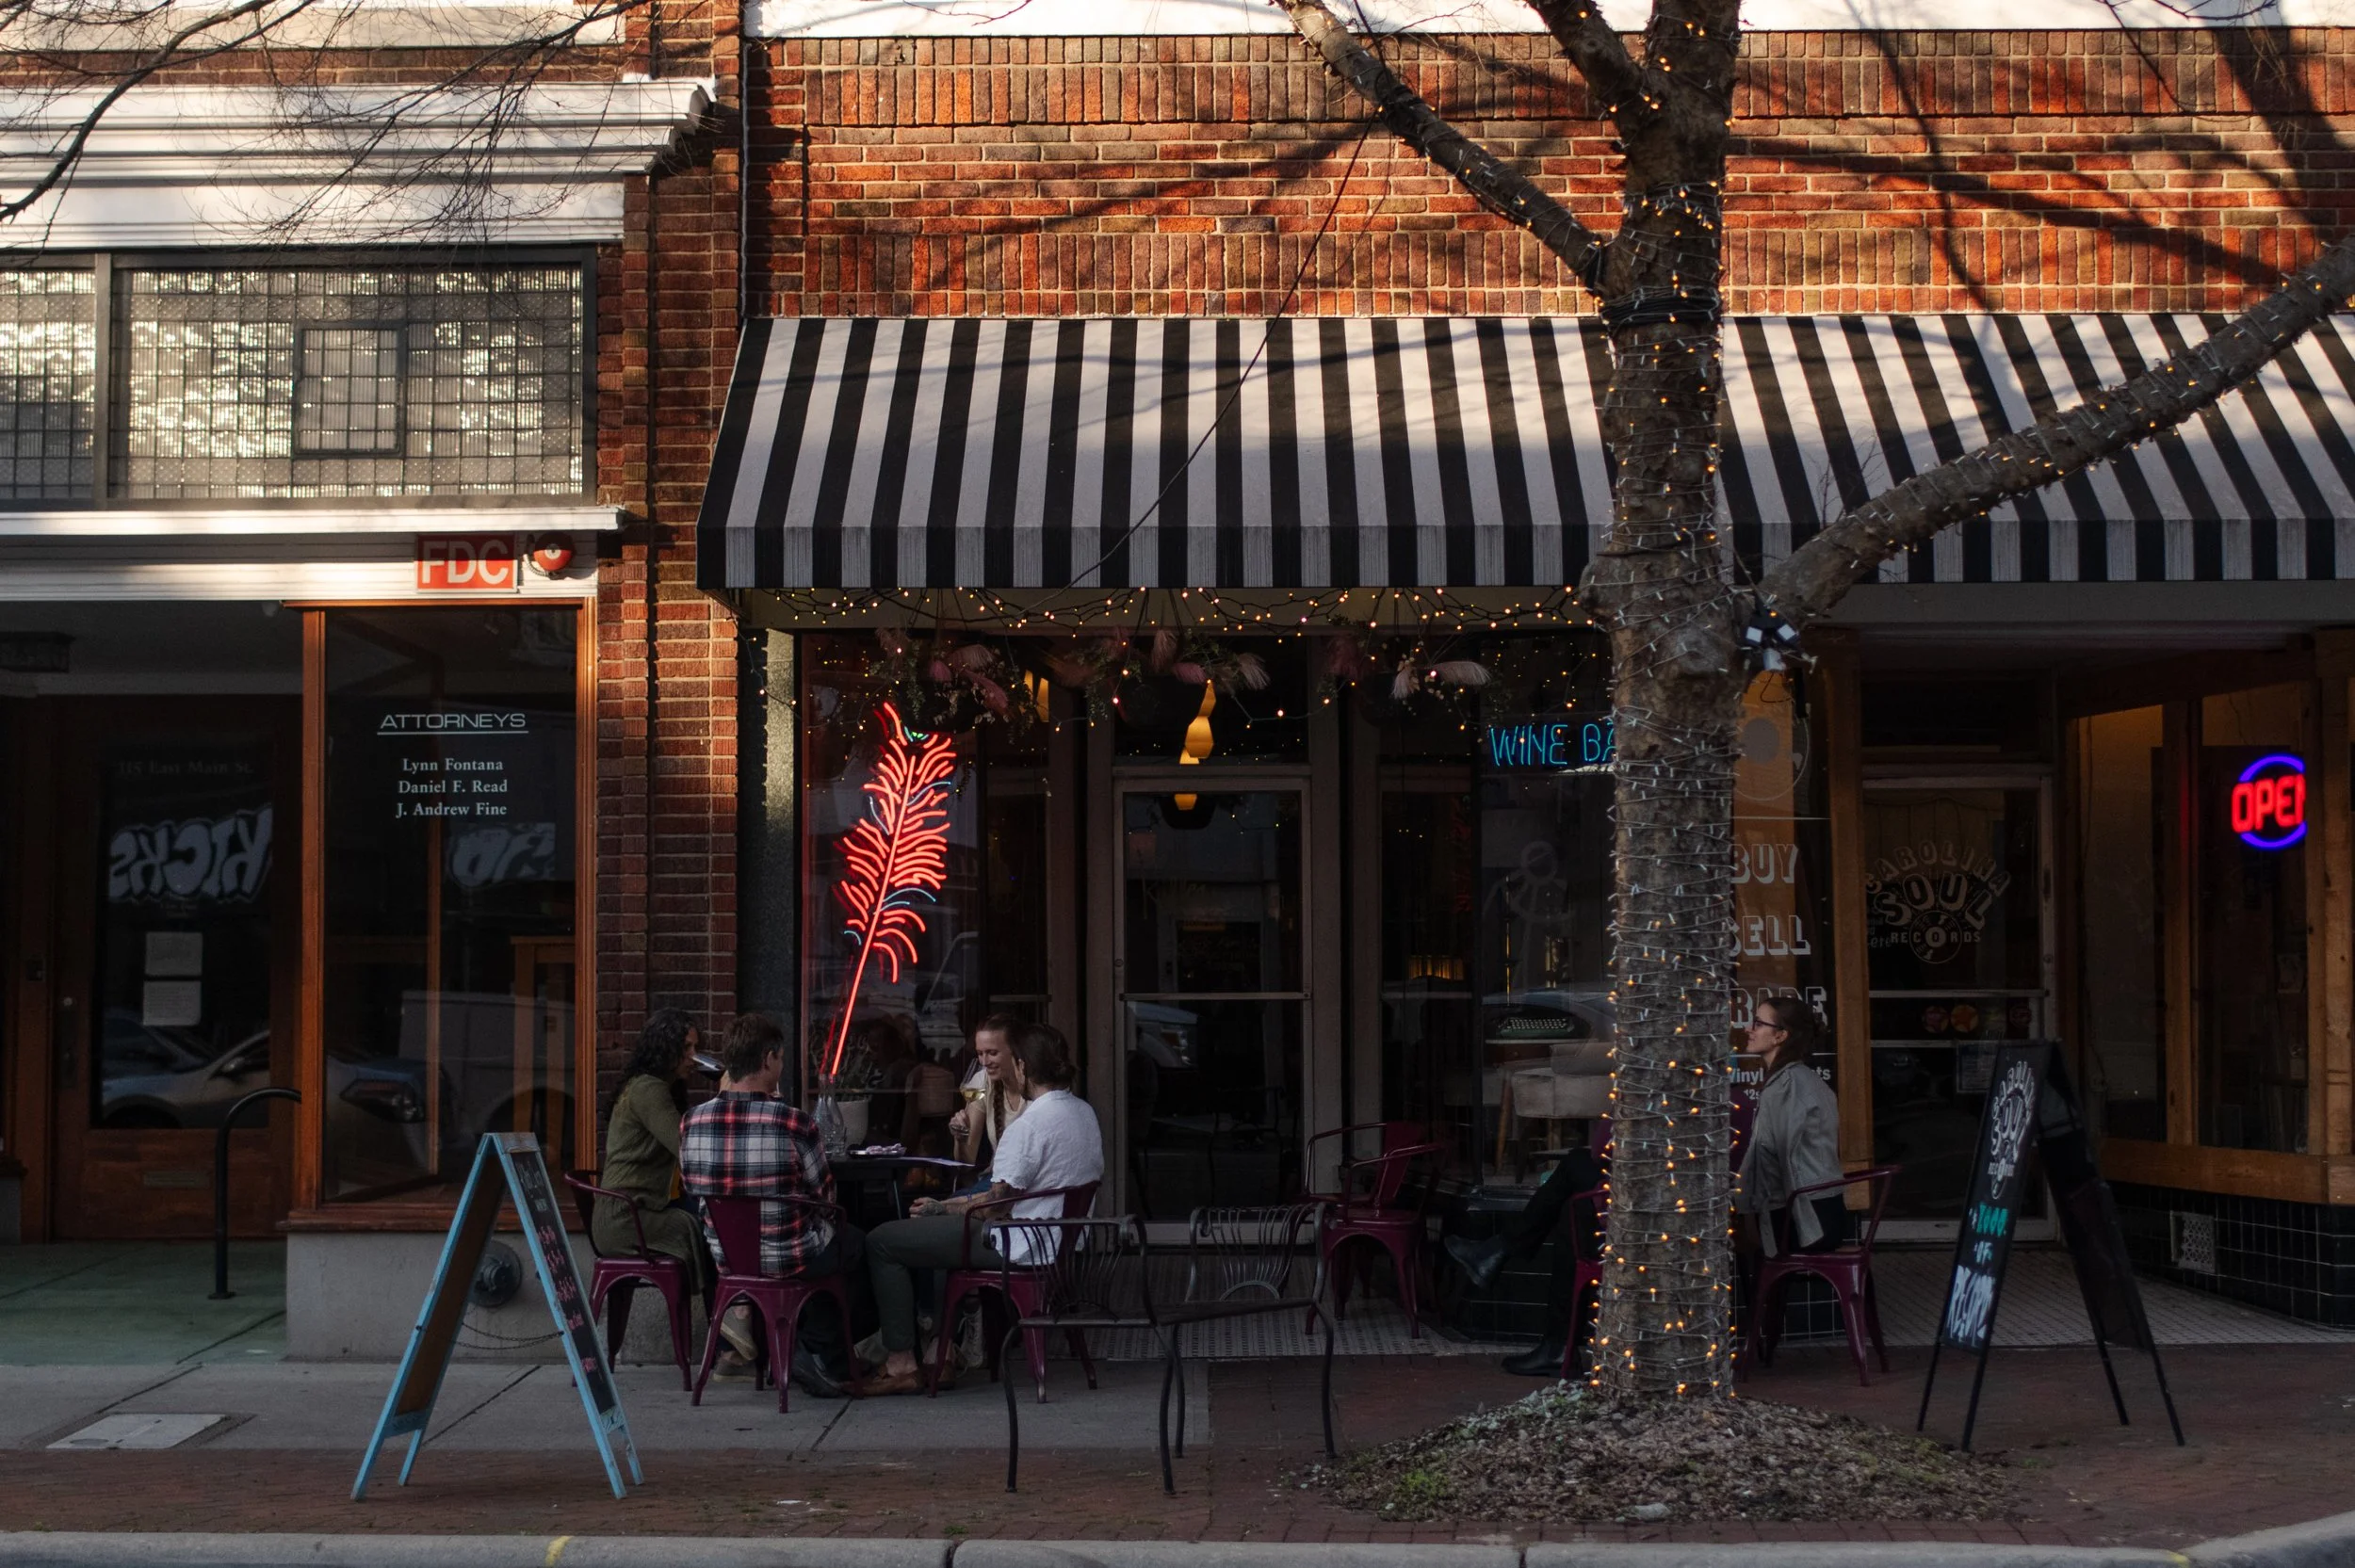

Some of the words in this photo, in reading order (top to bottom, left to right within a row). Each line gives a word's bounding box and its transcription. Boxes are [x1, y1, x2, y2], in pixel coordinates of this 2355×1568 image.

[422, 540, 509, 585] FDC
[380, 713, 527, 729] ATTORNEYS
[1490, 723, 1568, 768] WINE
[1583, 720, 1615, 762] BA
[187, 759, 227, 774] Main
[402, 757, 439, 775] Lynn
[445, 757, 504, 771] Fontana
[398, 780, 447, 794] Daniel
[452, 780, 466, 794] F.
[472, 779, 509, 794] Read
[395, 802, 408, 819] J.
[412, 802, 471, 816] Andrew
[475, 802, 508, 816] Fine
[1730, 843, 1799, 884] BUY
[1866, 840, 2012, 897] CAROLINA
[1873, 870, 1993, 930] SOUL
[1890, 929, 1982, 946] RECORDS
